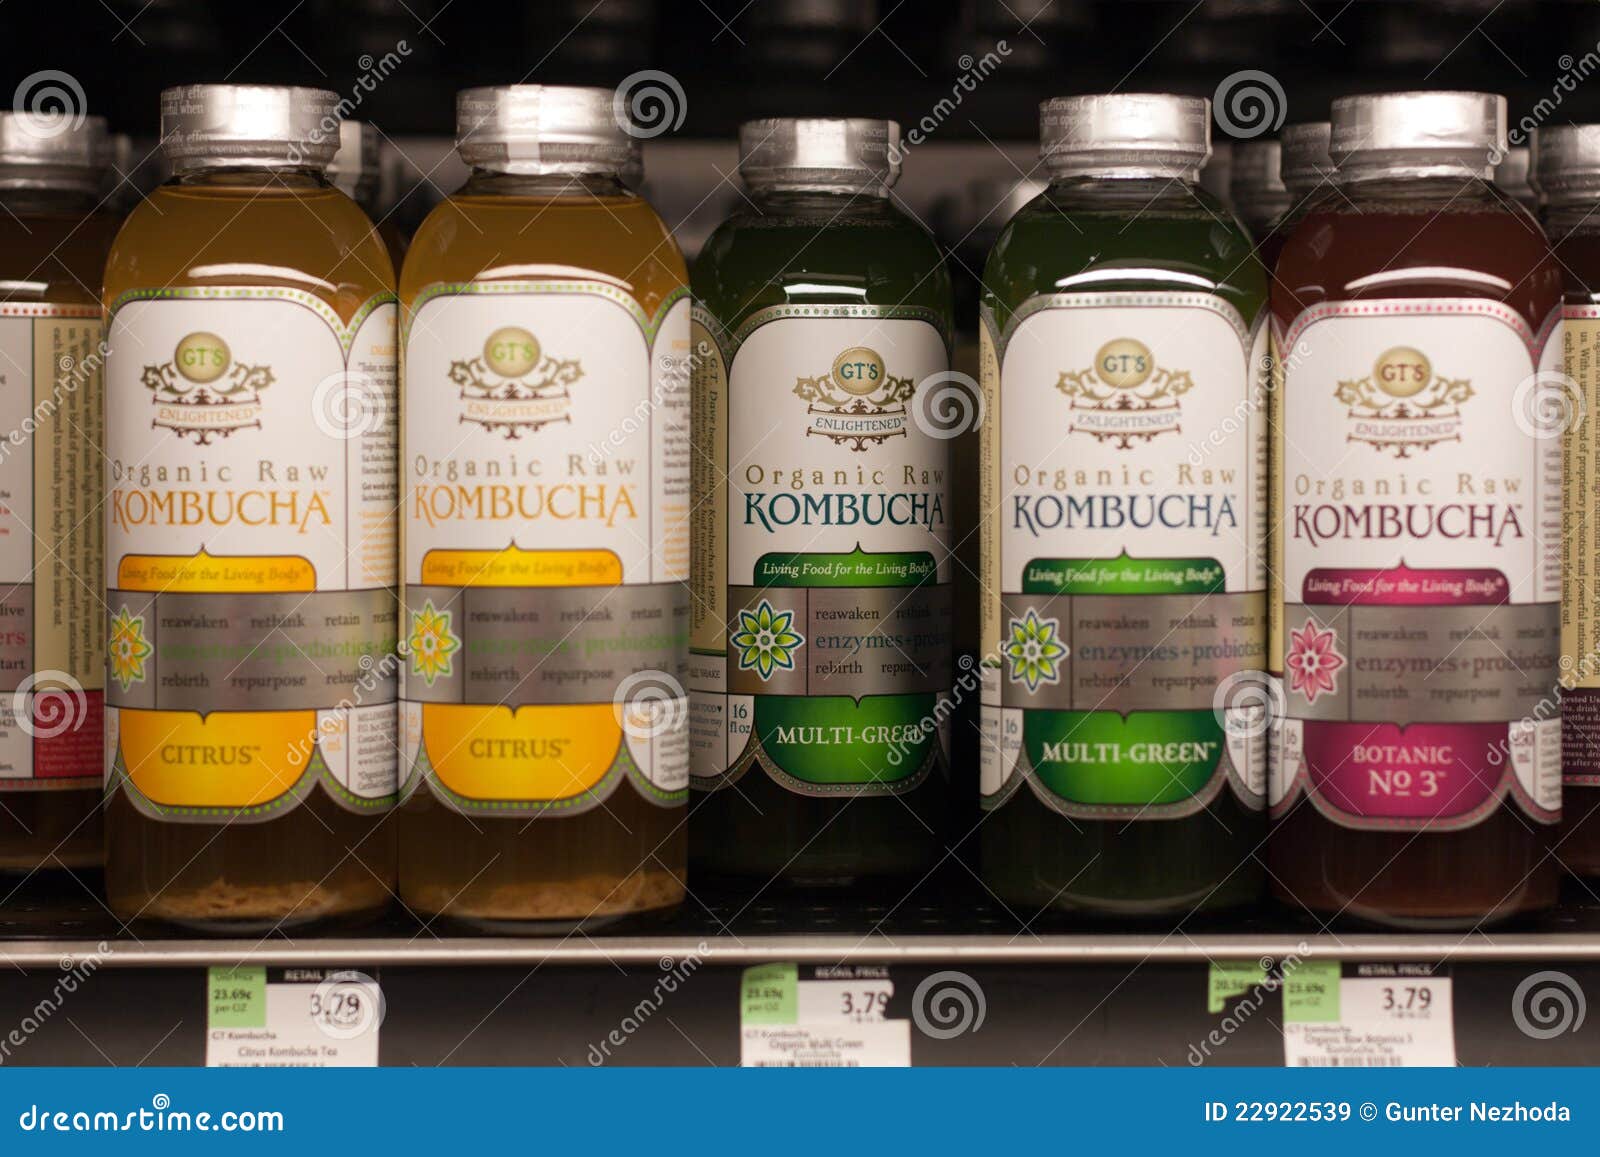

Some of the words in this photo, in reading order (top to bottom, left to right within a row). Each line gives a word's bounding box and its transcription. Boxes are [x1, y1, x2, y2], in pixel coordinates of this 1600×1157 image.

[1564, 332, 1574, 353] each
[1580, 332, 1588, 345] us.
[1103, 354, 1146, 373] GT'S
[1580, 348, 1590, 370] With
[840, 363, 879, 381] GT'S
[1381, 363, 1425, 382] GT'S
[1579, 415, 1590, 441] blend
[708, 427, 718, 462] began
[112, 461, 232, 487] Organic
[259, 460, 329, 482] Raw
[415, 454, 543, 481] Organic
[568, 454, 635, 476] Raw
[745, 464, 884, 490] Organic
[903, 464, 945, 485] Raw
[1014, 463, 1153, 491] Organic
[1178, 464, 1236, 485] Raw
[1563, 450, 1573, 486] nourish
[1295, 473, 1432, 500] Organic
[1457, 472, 1522, 495] Raw
[1576, 456, 1588, 507] proprietary
[1561, 488, 1572, 510] your
[1561, 512, 1573, 535] body
[707, 509, 717, 567] Kombucha
[1575, 510, 1588, 558] probiotics
[1562, 537, 1573, 560] from
[763, 562, 799, 578] Living
[802, 562, 832, 576] Food
[832, 562, 853, 578] for
[855, 562, 873, 576] the
[876, 562, 907, 578] Living
[1029, 568, 1063, 585] Living
[1066, 568, 1097, 583] Food
[1097, 567, 1118, 586] for
[1122, 567, 1141, 583] the
[1145, 567, 1184, 586] Living
[1578, 559, 1588, 576] and
[1307, 579, 1341, 597] Living
[1343, 579, 1375, 594] Food
[1374, 578, 1396, 597] for
[1399, 578, 1419, 595] the
[1422, 579, 1465, 598] Living
[1562, 580, 1573, 607] inside
[1575, 578, 1589, 620] powerful
[250, 614, 305, 629] rethink
[325, 612, 361, 626] retain
[815, 607, 880, 620] reawaken
[1079, 615, 1150, 630] reawaken
[1562, 610, 1572, 627] out.
[470, 668, 520, 683] rebirth
[815, 662, 863, 675] rebirth
[161, 674, 210, 689] rebirth
[231, 676, 307, 690] repurpose
[733, 703, 748, 719] 16
[730, 722, 737, 733] fl
[738, 724, 751, 733] oz
[776, 726, 928, 746] MULTI-GREEN
[1005, 718, 1019, 734] 16
[1353, 745, 1454, 764] BOTANIC
[284, 969, 323, 981] RETAIL
[326, 969, 358, 981] PRICE
[310, 993, 359, 1017] 3.79
[841, 991, 889, 1015] 3.79
[1383, 987, 1432, 1010] 3.79
[228, 1031, 277, 1041] Kombucha
[238, 1046, 266, 1057] Citrus
[269, 1046, 318, 1057] Kombucha
[322, 1046, 338, 1057] Tea
